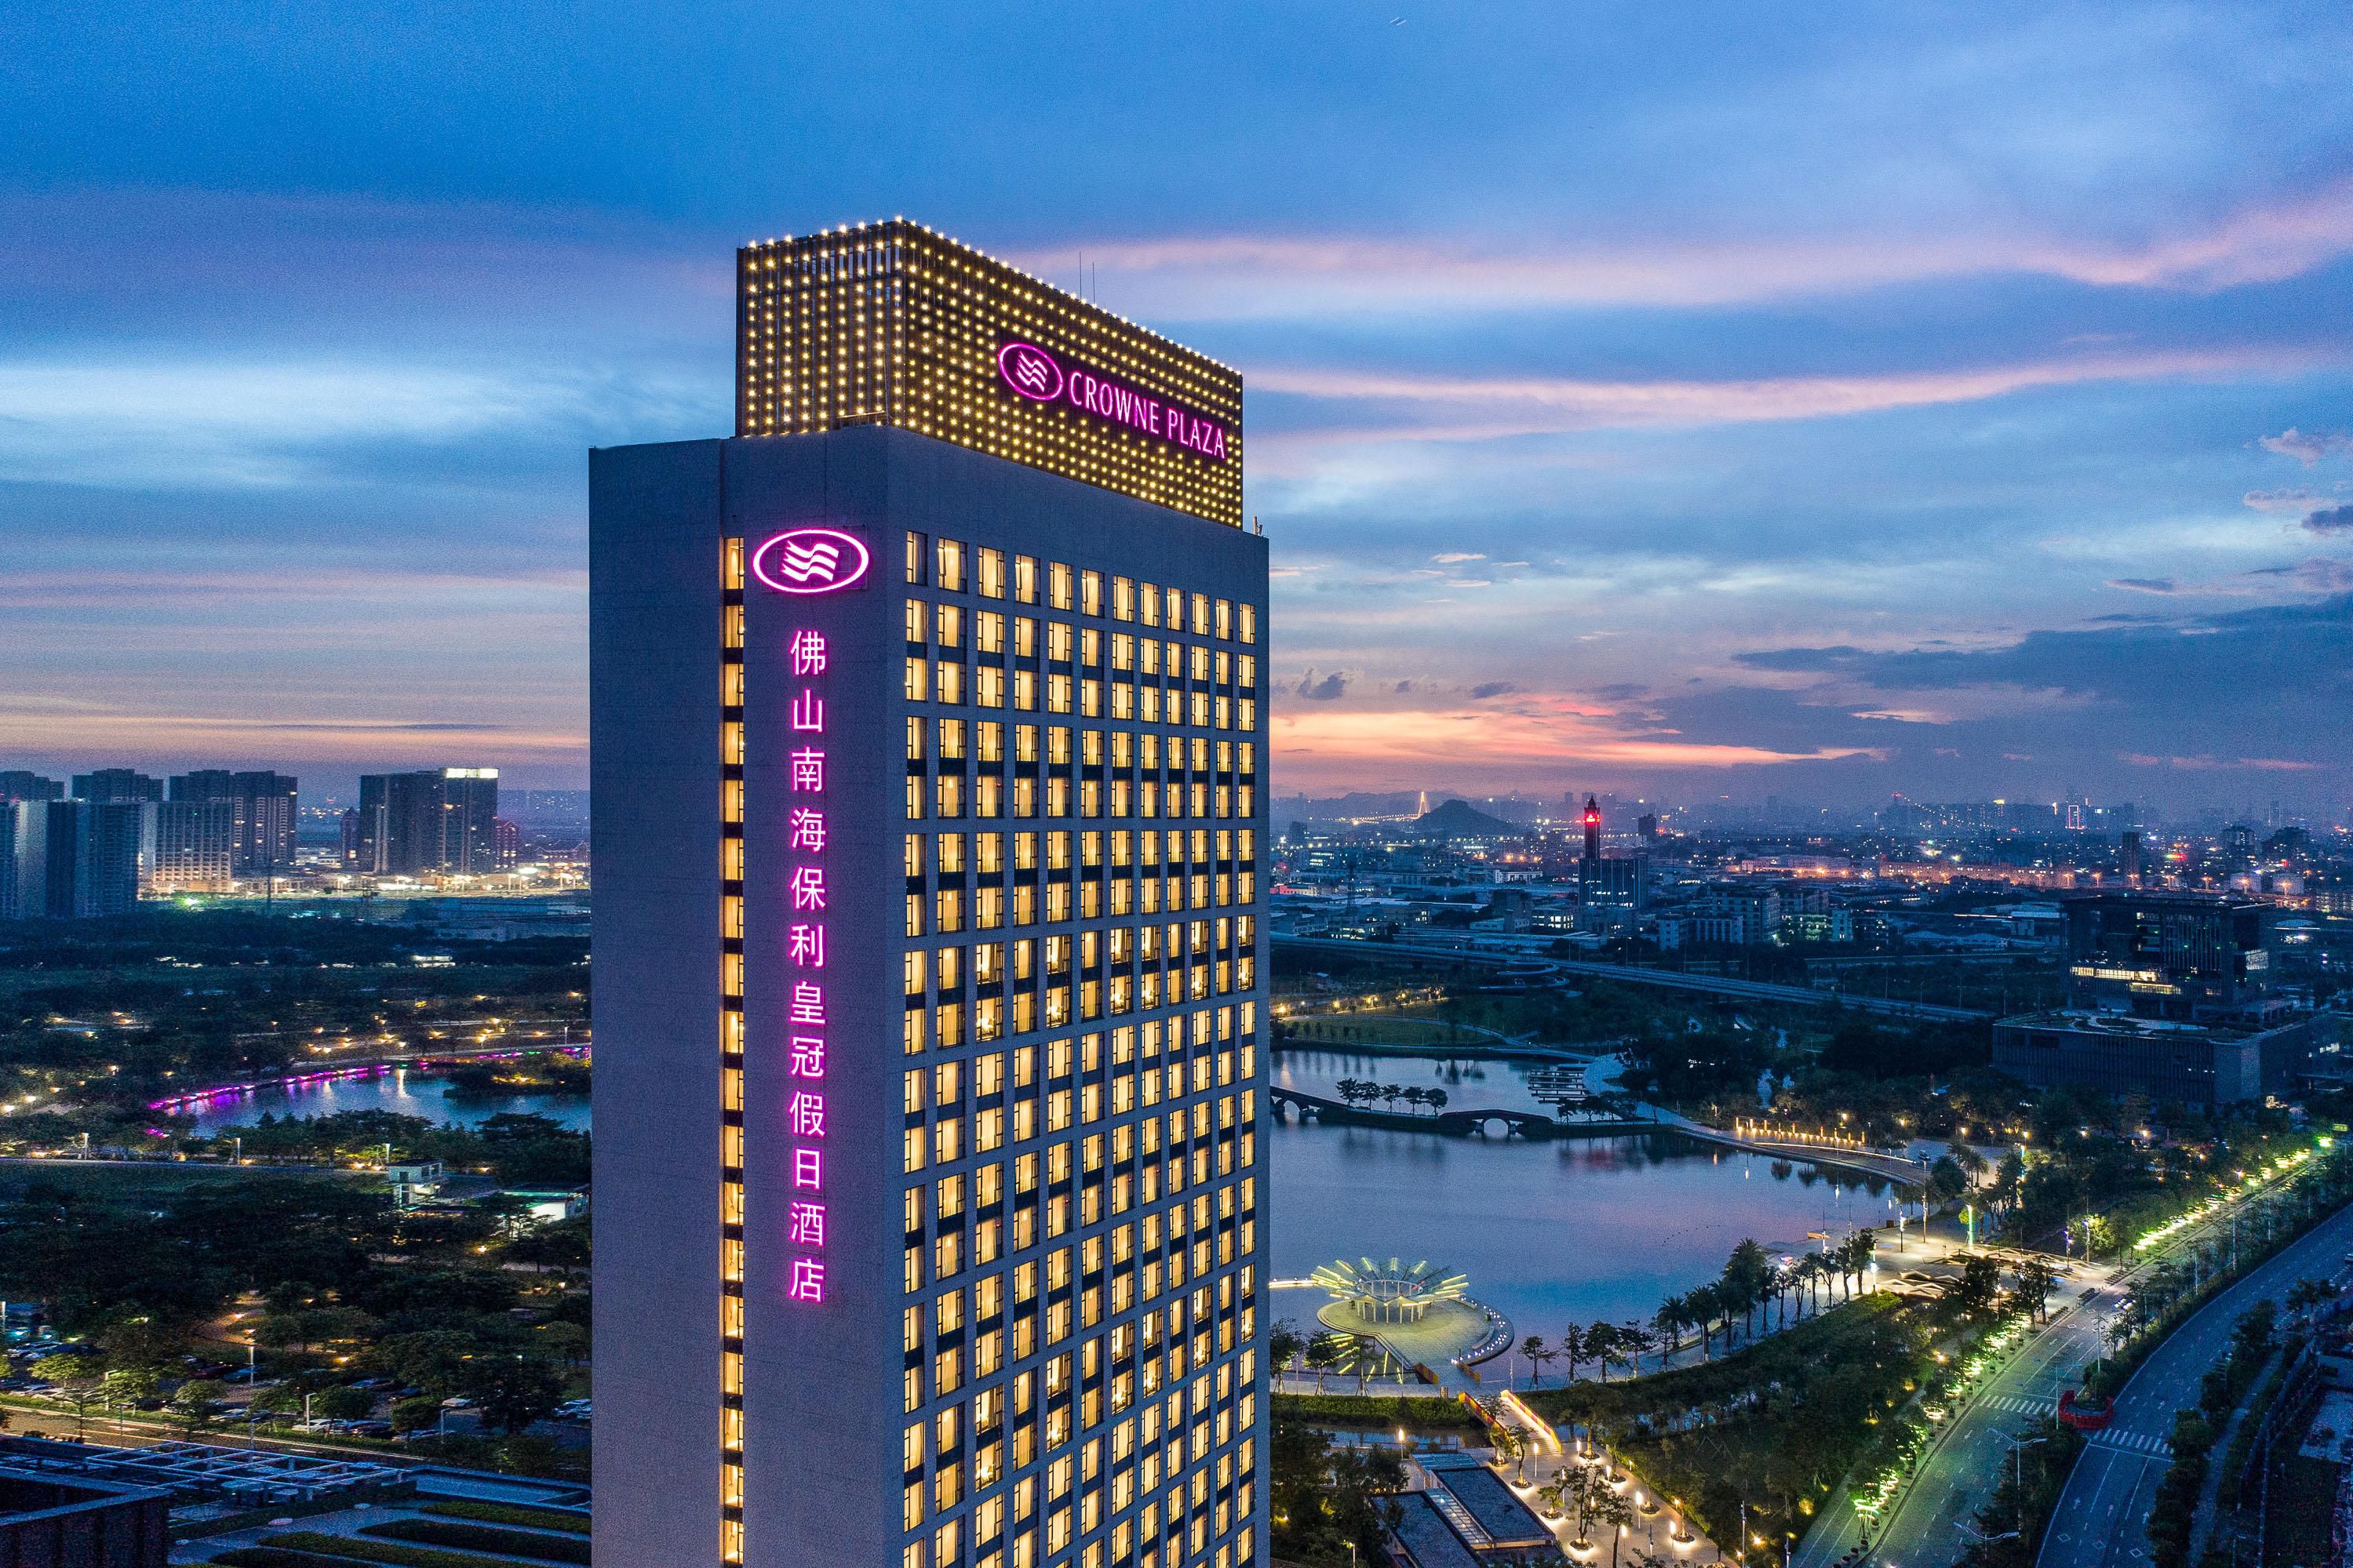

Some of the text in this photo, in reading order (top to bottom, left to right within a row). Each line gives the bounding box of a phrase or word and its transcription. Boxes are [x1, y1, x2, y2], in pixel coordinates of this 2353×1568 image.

[1071, 372, 1226, 459] CROWNE PLAZA
[789, 630, 826, 1303] 佛山南海保利皇冠假日酒店
